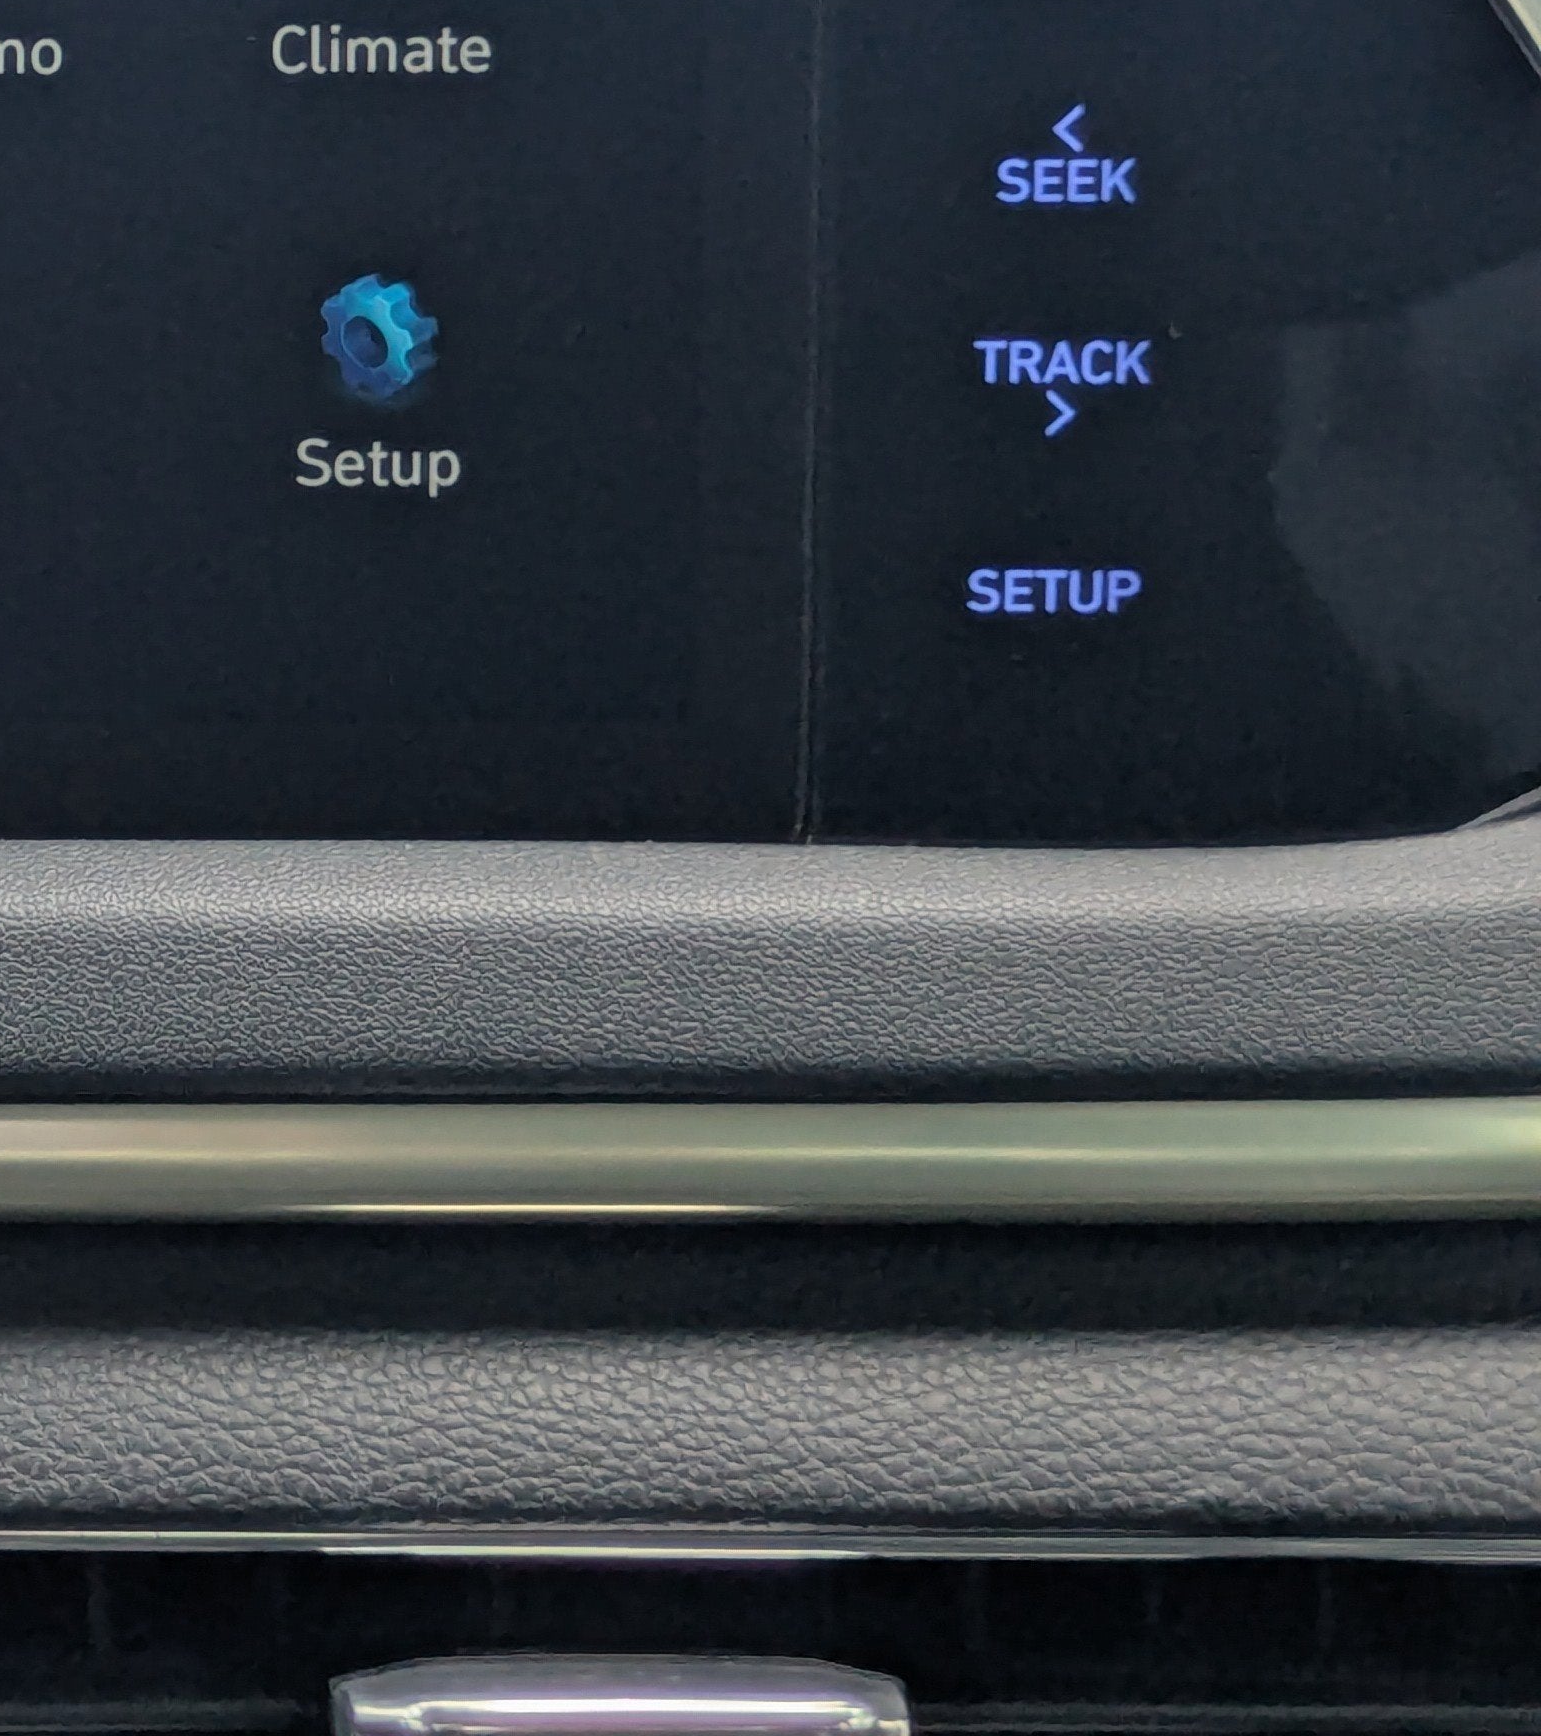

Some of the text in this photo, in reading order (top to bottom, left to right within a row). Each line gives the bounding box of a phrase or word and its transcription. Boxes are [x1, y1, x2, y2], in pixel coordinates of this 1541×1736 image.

[272, 24, 492, 75] Climate
[996, 157, 1135, 203] SEEK
[973, 339, 1150, 385] TRACK
[295, 437, 461, 498] Setup
[966, 568, 1142, 614] SETUP
